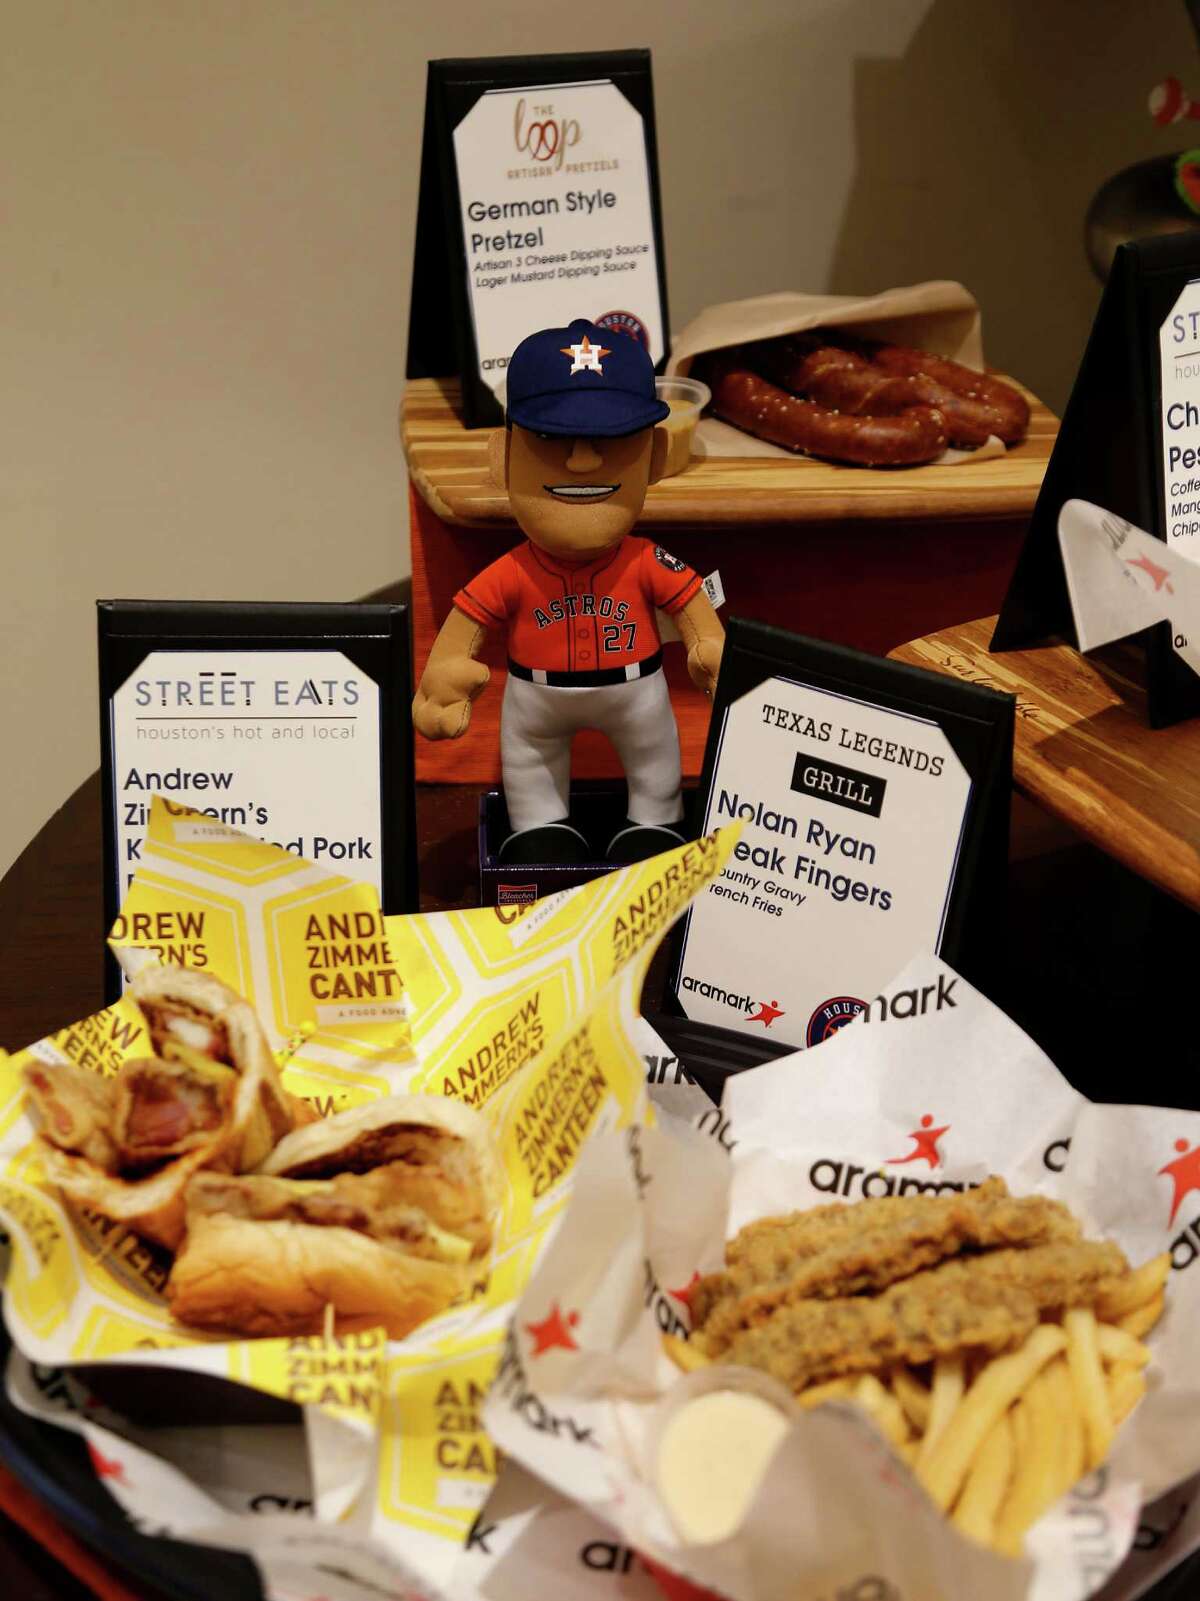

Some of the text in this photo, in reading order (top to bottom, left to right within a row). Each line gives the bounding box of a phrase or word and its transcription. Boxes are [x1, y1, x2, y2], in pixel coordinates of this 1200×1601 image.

[533, 105, 554, 115] THE
[514, 98, 581, 171] loop
[507, 159, 619, 179] ARTISAN PRETZELS
[468, 189, 617, 222] German Style
[471, 226, 544, 253] Pretzel
[474, 243, 649, 272] Artisan 3 Cheese Dipping Sauce
[476, 260, 637, 288] Lager Mustard Dipping Sauce
[1172, 520, 1200, 538] Chip
[533, 594, 629, 628] ASTROS
[603, 624, 636, 653] 27
[136, 672, 359, 706] STREET EATS
[136, 725, 355, 740] houston's hot and local
[762, 704, 944, 776] TEXAS LEGENDS
[124, 768, 233, 790] Andrew
[803, 766, 872, 805] GRILL
[125, 803, 268, 826] Ziern's
[718, 790, 875, 864] Nolan Ryan
[314, 838, 373, 860] Pork
[719, 869, 806, 906] ountry Gravy
[794, 855, 892, 910] Fingers
[709, 882, 783, 917] rench Fries
[681, 975, 755, 1014] aramark
[443, 991, 539, 1096] ANDREW
